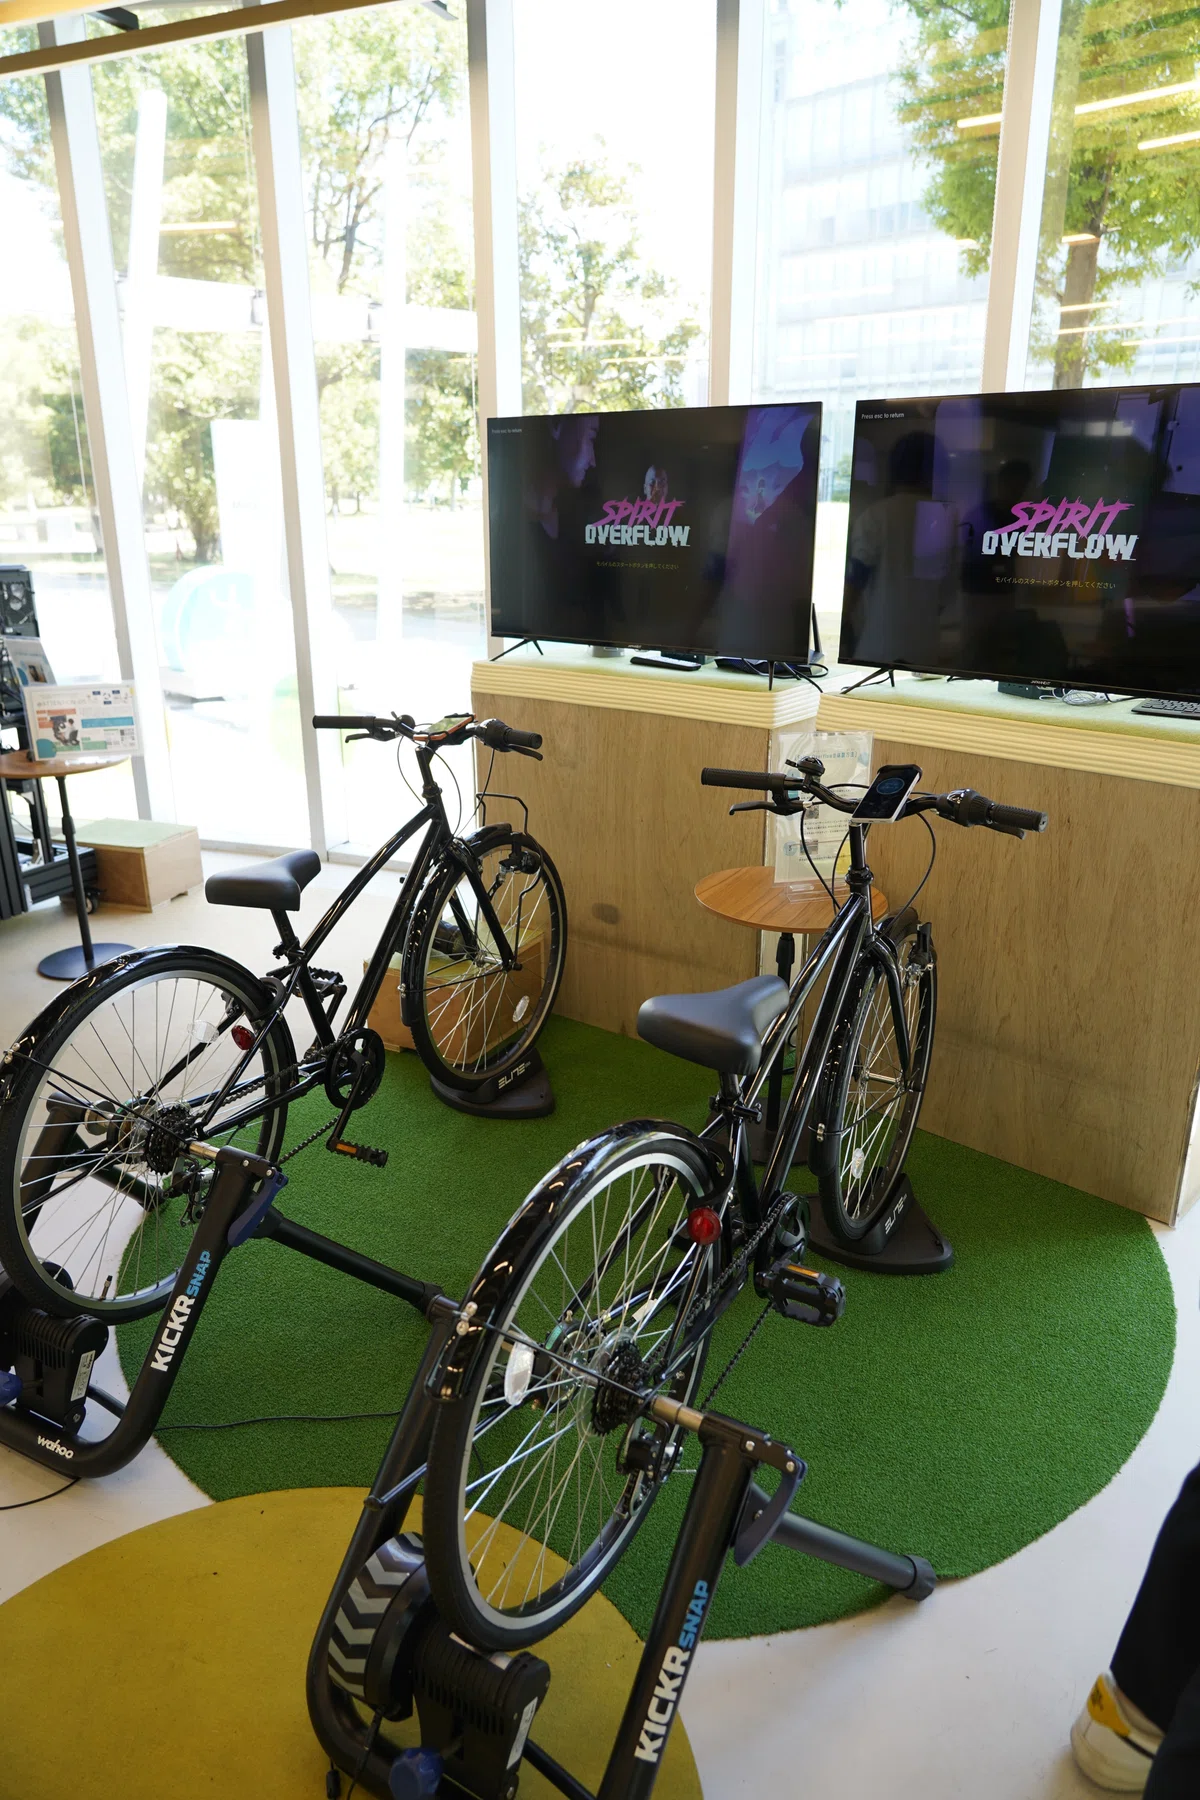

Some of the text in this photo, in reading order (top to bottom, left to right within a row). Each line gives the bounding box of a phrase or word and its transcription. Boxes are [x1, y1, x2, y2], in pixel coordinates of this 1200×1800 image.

[591, 496, 686, 529] SPIRIT
[992, 496, 1135, 539] SPIRIT
[584, 524, 691, 547] OVERFLOW
[981, 530, 1139, 561] OVERFLOW
[995, 576, 1116, 589] モバイルのスタートボタンを押してください
[498, 1063, 526, 1089] ELITE
[885, 1196, 904, 1234] ELITE
[150, 1250, 211, 1372] KICKR SNAP
[37, 1435, 74, 1459] wahoo
[634, 1580, 708, 1763] KICKR SNAP
